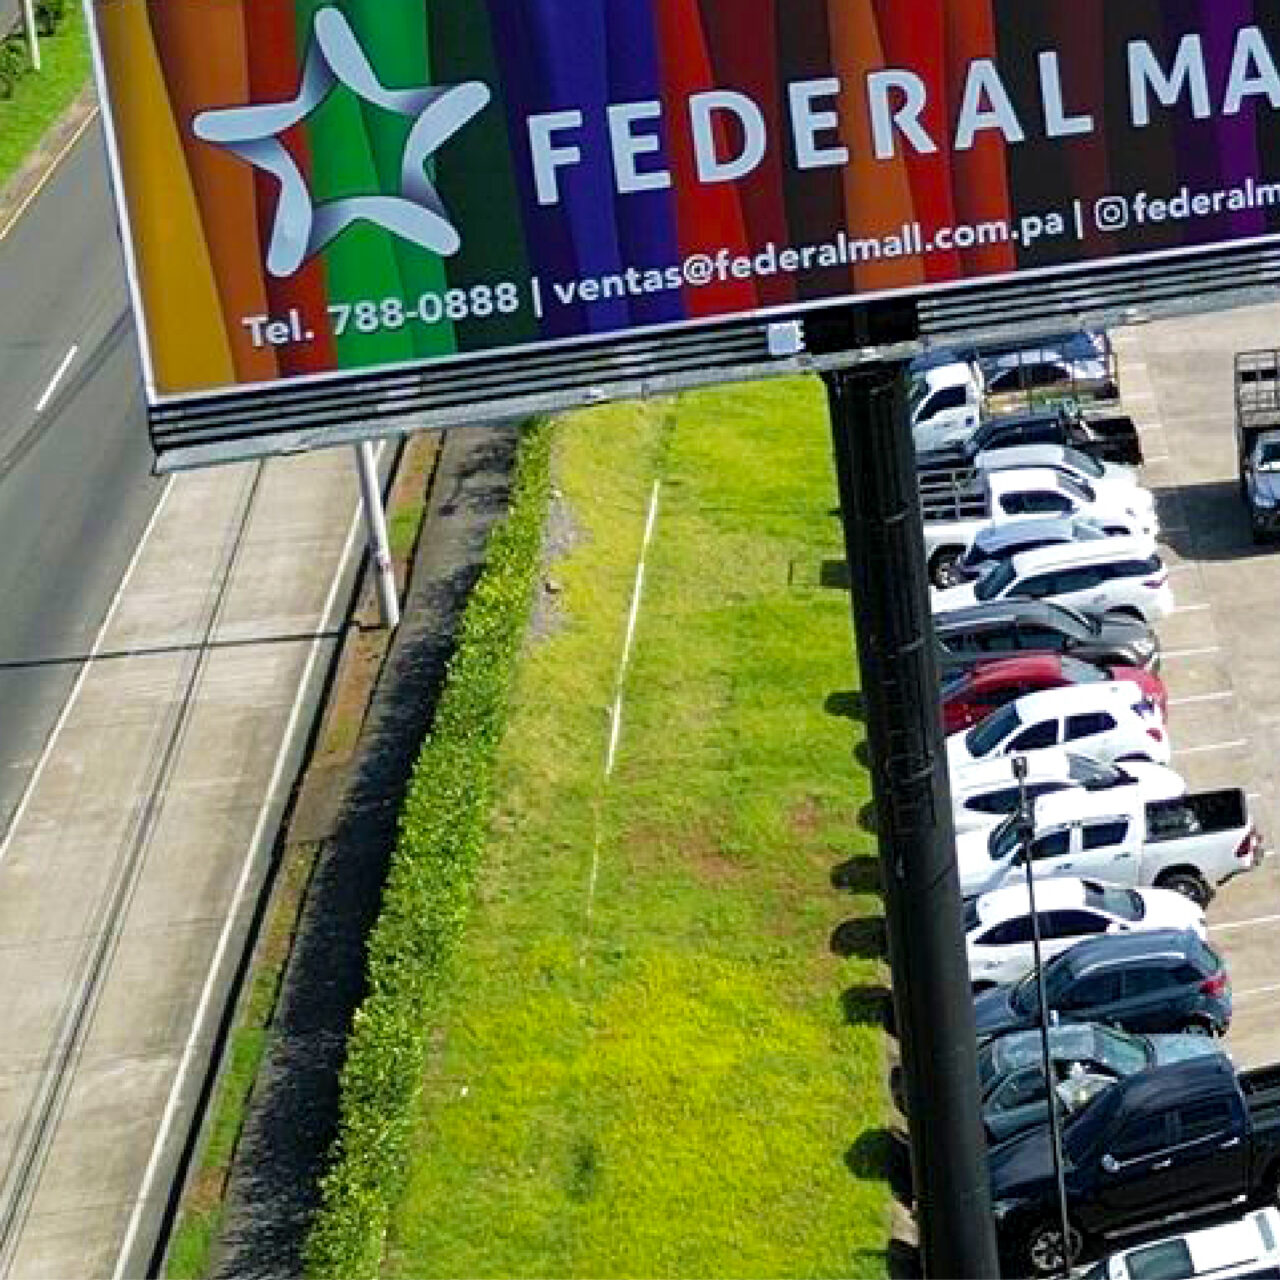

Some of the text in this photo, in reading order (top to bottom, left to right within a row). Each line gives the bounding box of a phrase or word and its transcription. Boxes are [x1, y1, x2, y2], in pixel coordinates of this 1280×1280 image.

[528, 51, 1094, 205] FEDERAL
[242, 314, 315, 347] Tel.
[327, 282, 519, 335] 788-0888
[553, 213, 1064, 305] ventas@federalmall.com.pa
